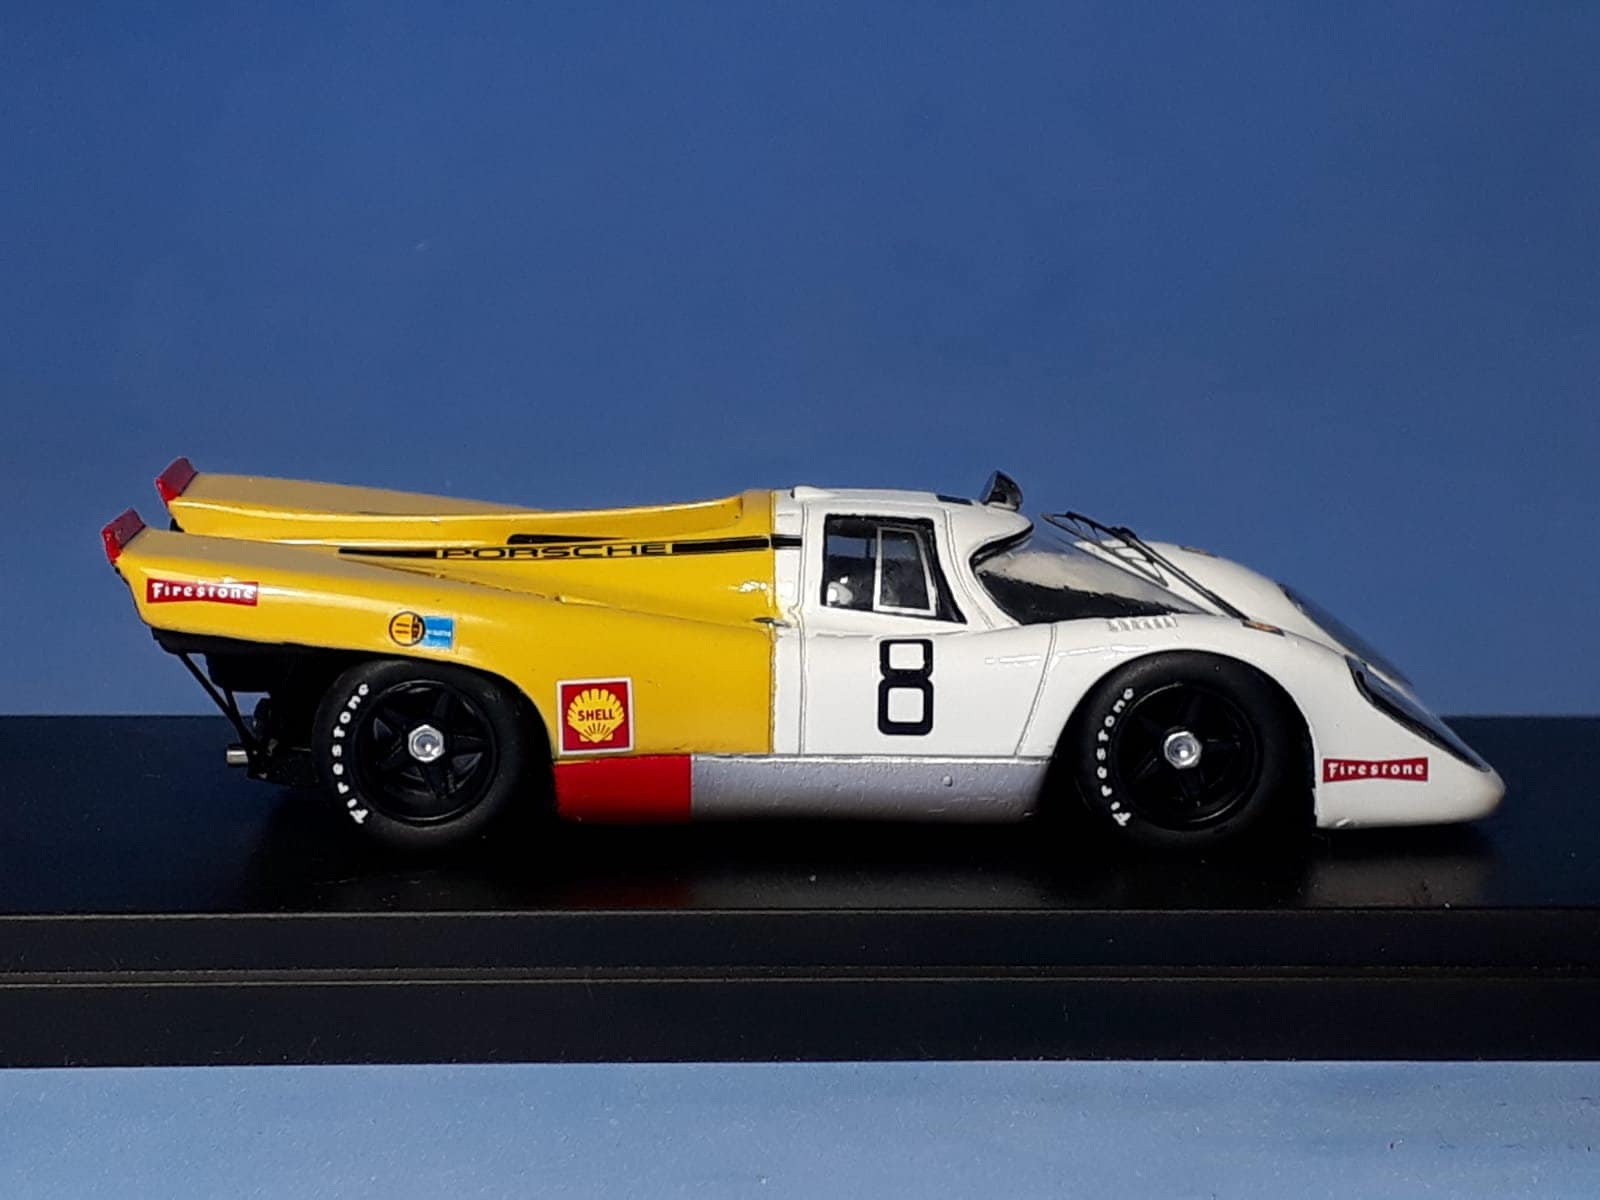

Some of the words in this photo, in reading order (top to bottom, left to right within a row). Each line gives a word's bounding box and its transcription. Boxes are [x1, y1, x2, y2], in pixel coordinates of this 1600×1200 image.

[441, 544, 667, 560] PORSCHE
[151, 582, 255, 600] Firestone
[878, 638, 934, 736] 8
[577, 708, 616, 722] SHELL
[331, 683, 369, 824] Firestone
[1096, 688, 1132, 826] Firestone
[1327, 762, 1424, 779] Firestone
